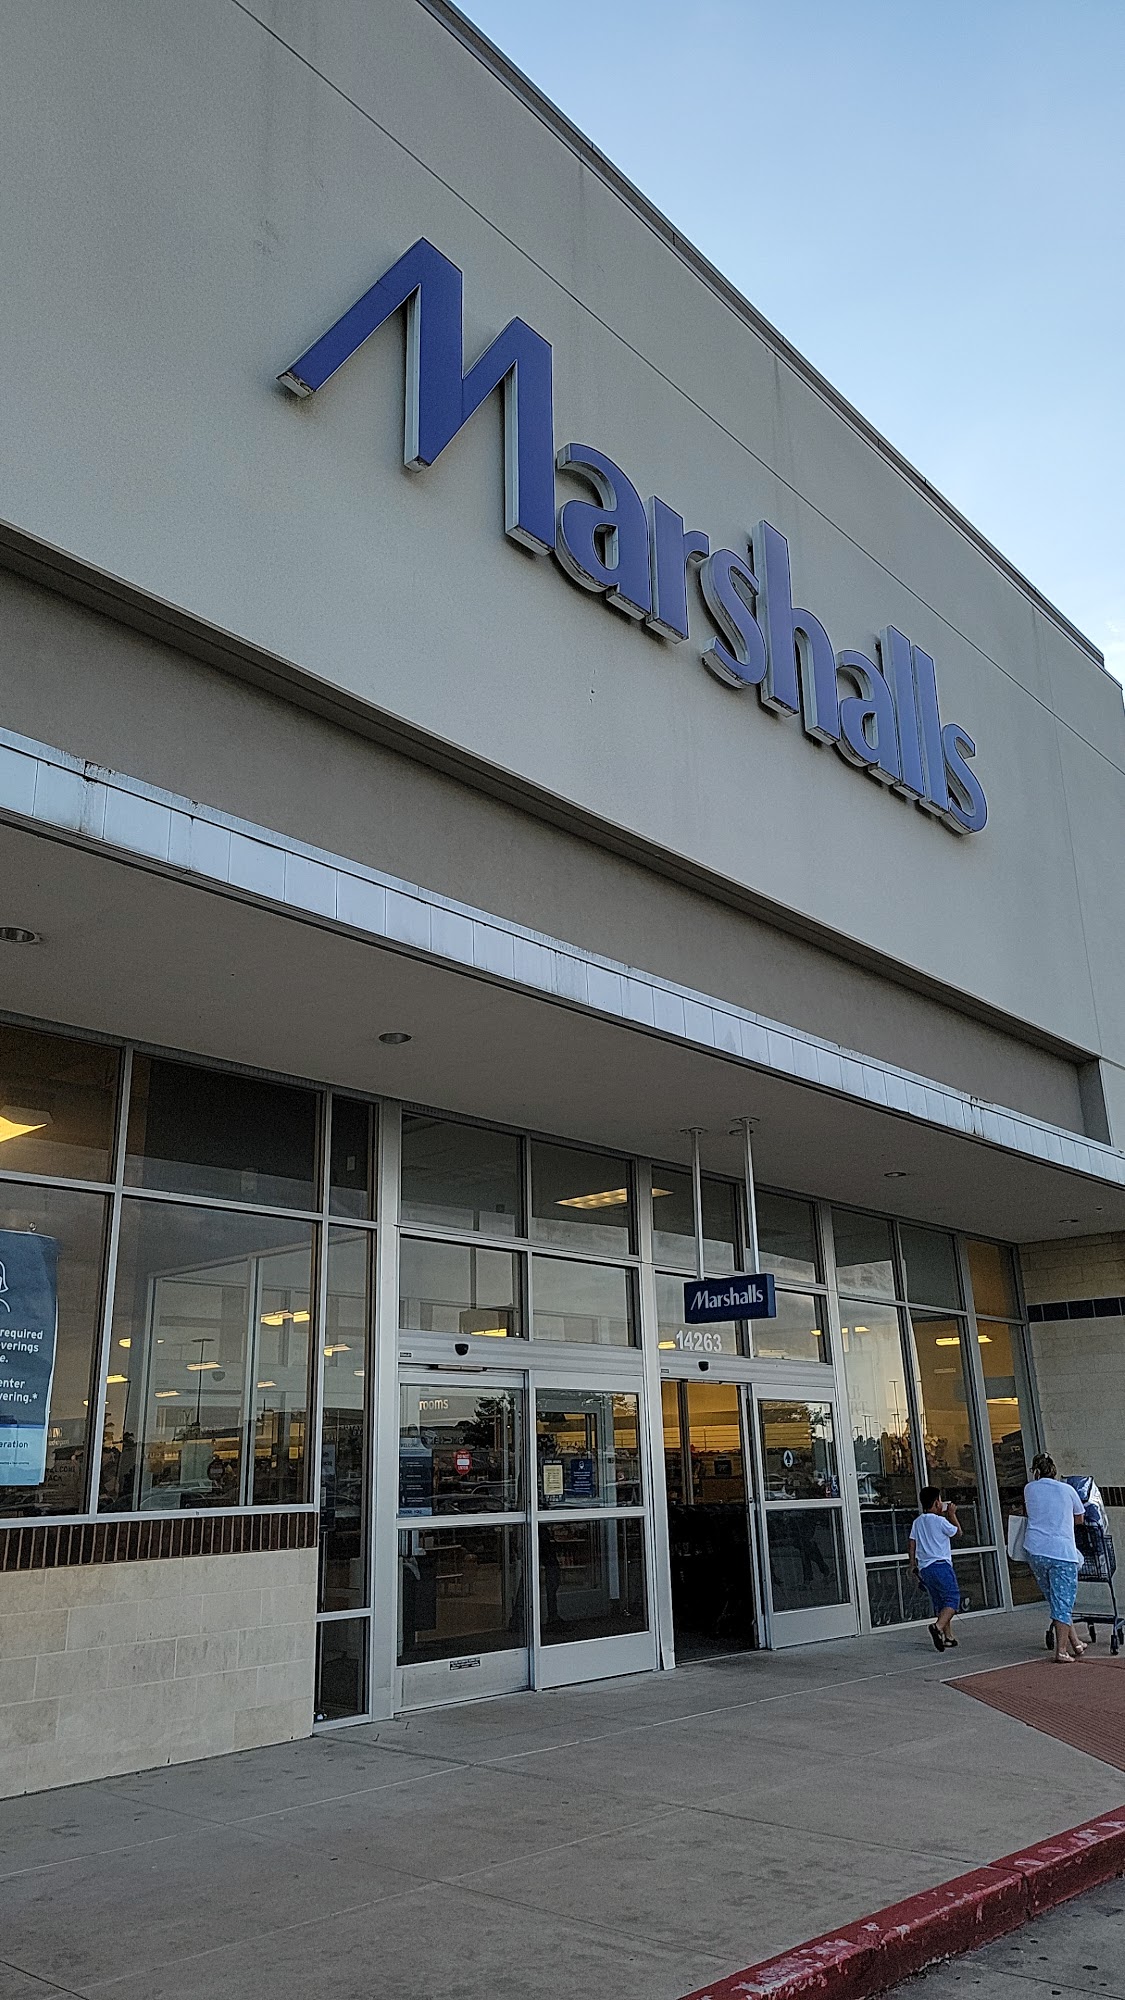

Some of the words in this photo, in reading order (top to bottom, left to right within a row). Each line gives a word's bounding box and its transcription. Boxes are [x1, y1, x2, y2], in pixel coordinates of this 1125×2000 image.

[277, 237, 988, 836] Marshalls
[690, 1284, 764, 1311] Marshalls
[0, 1328, 43, 1340] required
[676, 1330, 722, 1352] 14263
[0, 1378, 26, 1389] enter
[419, 1399, 449, 1410] rooms
